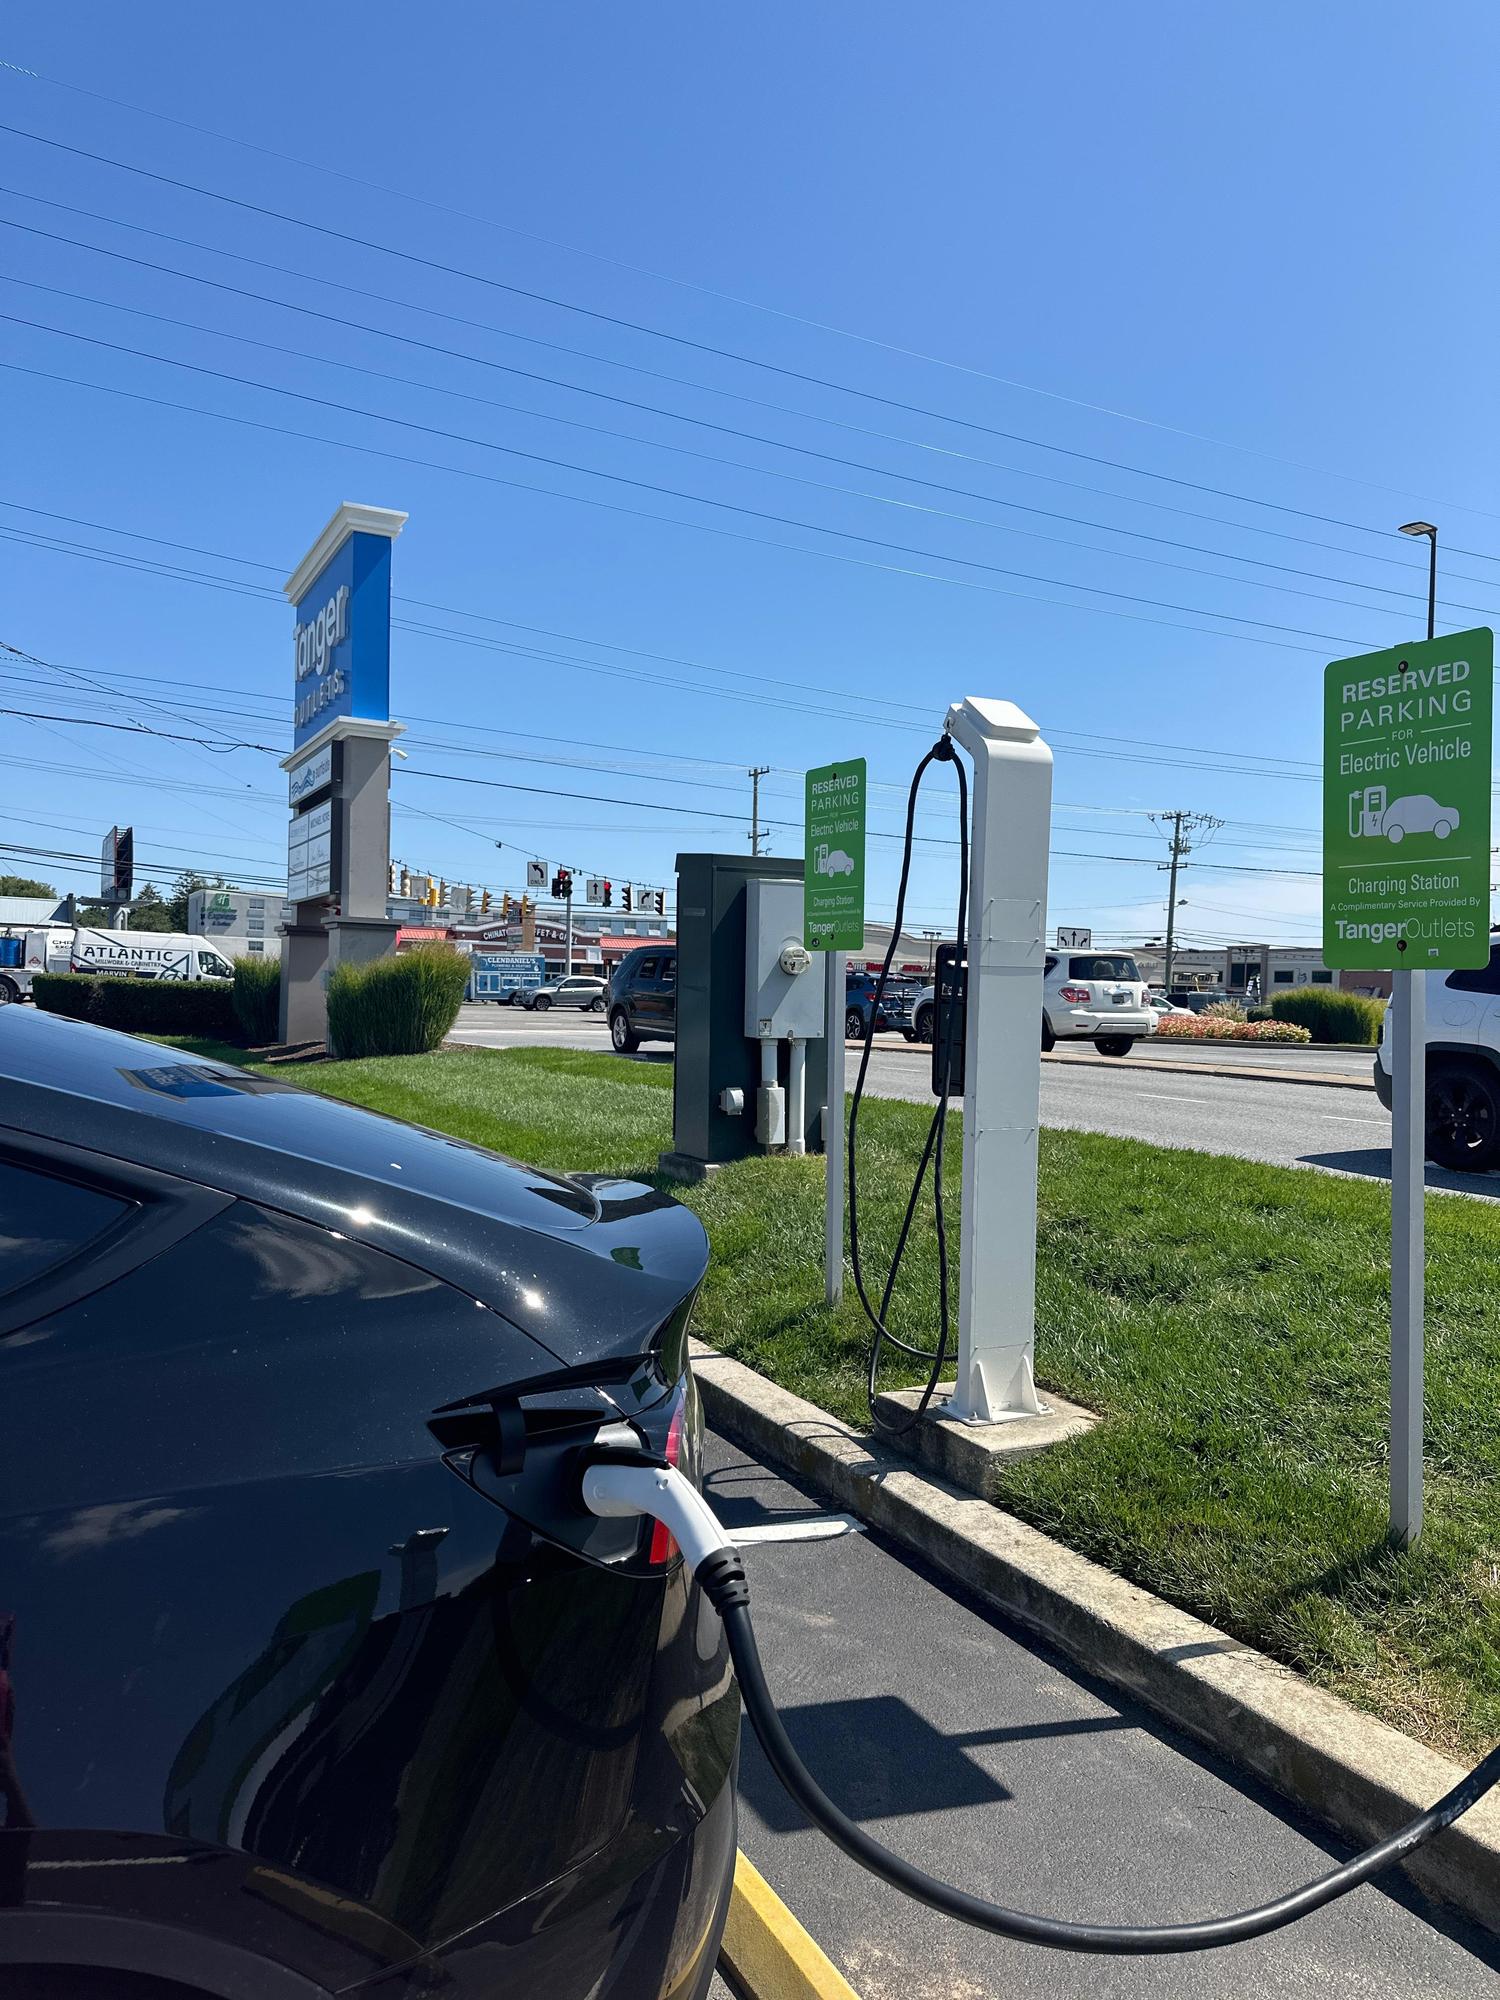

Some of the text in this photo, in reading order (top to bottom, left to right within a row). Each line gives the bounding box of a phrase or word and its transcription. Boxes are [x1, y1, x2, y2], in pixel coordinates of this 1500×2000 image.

[294, 584, 349, 681] Tanger
[1342, 660, 1470, 704] RESERVED
[294, 668, 345, 729] OUTLETS
[1341, 690, 1471, 732] PARKING
[1392, 729, 1413, 741] FOR
[1340, 737, 1471, 776] Electric Vehicle
[812, 775, 858, 795] RESERVED
[811, 792, 859, 812] PARKING
[811, 819, 859, 837] Electric Vehicle
[1349, 872, 1460, 896] Charging Station
[813, 895, 855, 909] Charging Station
[1330, 897, 1481, 912] A Complimentary Service Provided By
[483, 928, 508, 940] CHINAT
[808, 920, 860, 936] TangerOutlets
[1335, 917, 1475, 944] TangerOutlets
[84, 946, 173, 961] ATLANTIC
[95, 958, 124, 966] MILLWORK
[131, 960, 162, 968] CABINETRY
